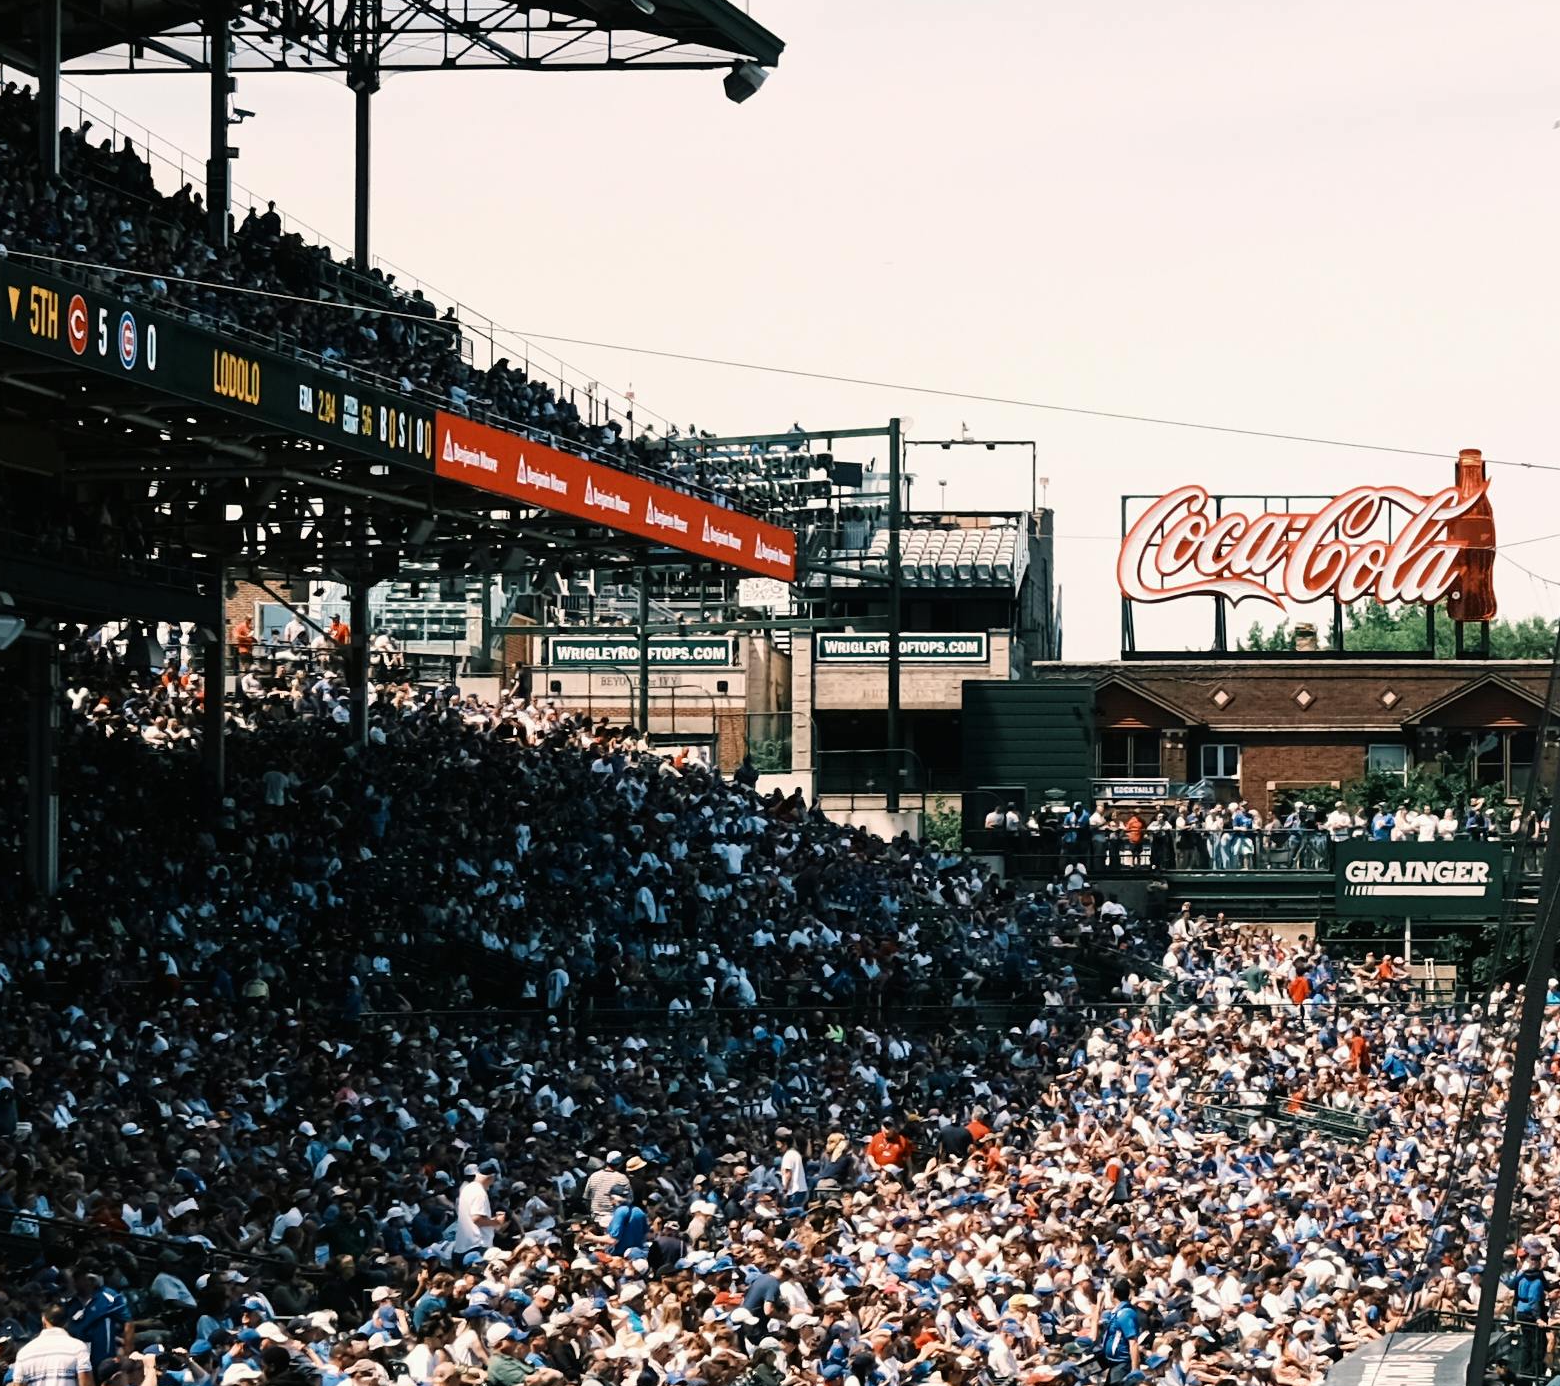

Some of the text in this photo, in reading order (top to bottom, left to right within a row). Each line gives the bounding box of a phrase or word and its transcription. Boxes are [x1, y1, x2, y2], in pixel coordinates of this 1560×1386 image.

[30, 285, 59, 340] 5TH
[98, 307, 108, 356] 5
[213, 348, 260, 405] LODOLO
[1117, 477, 1491, 612] Coca-Cola
[557, 645, 726, 662] WRIGLEYROFTOPS.COM
[824, 640, 978, 655] WRIGLEYROFTOPS.COM
[1345, 860, 1489, 884] GRAINGER
